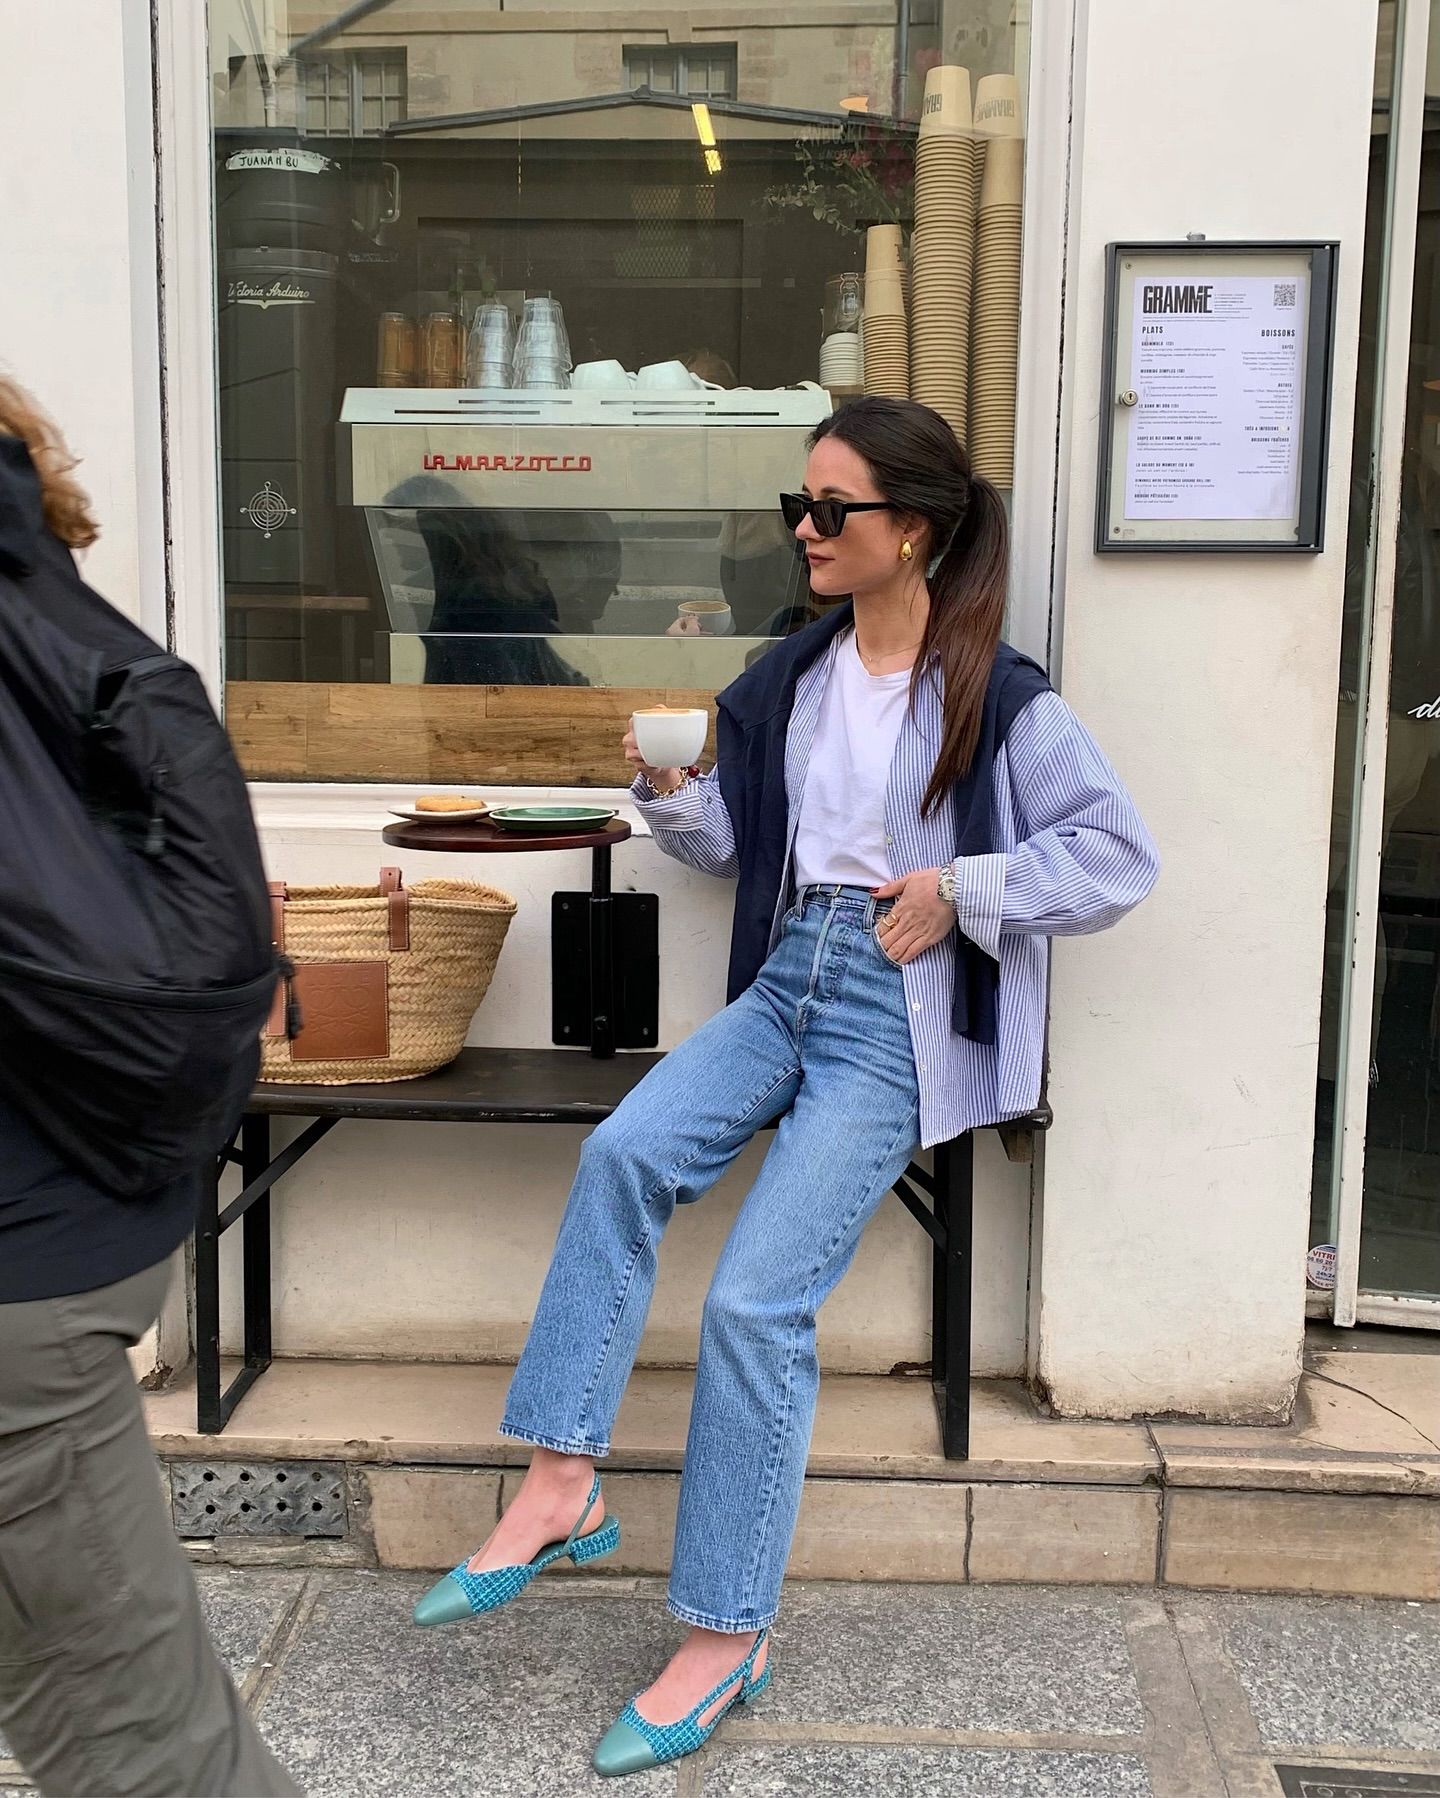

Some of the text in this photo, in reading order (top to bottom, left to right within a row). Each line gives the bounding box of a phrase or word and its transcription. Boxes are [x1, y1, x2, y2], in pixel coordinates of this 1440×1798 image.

[266, 281, 310, 298] Arduino
[1142, 285, 1214, 314] GRAMME
[1142, 326, 1164, 334] PLATS
[1261, 329, 1296, 337] BOISSONS
[424, 454, 592, 472] LA MARZOCCO
